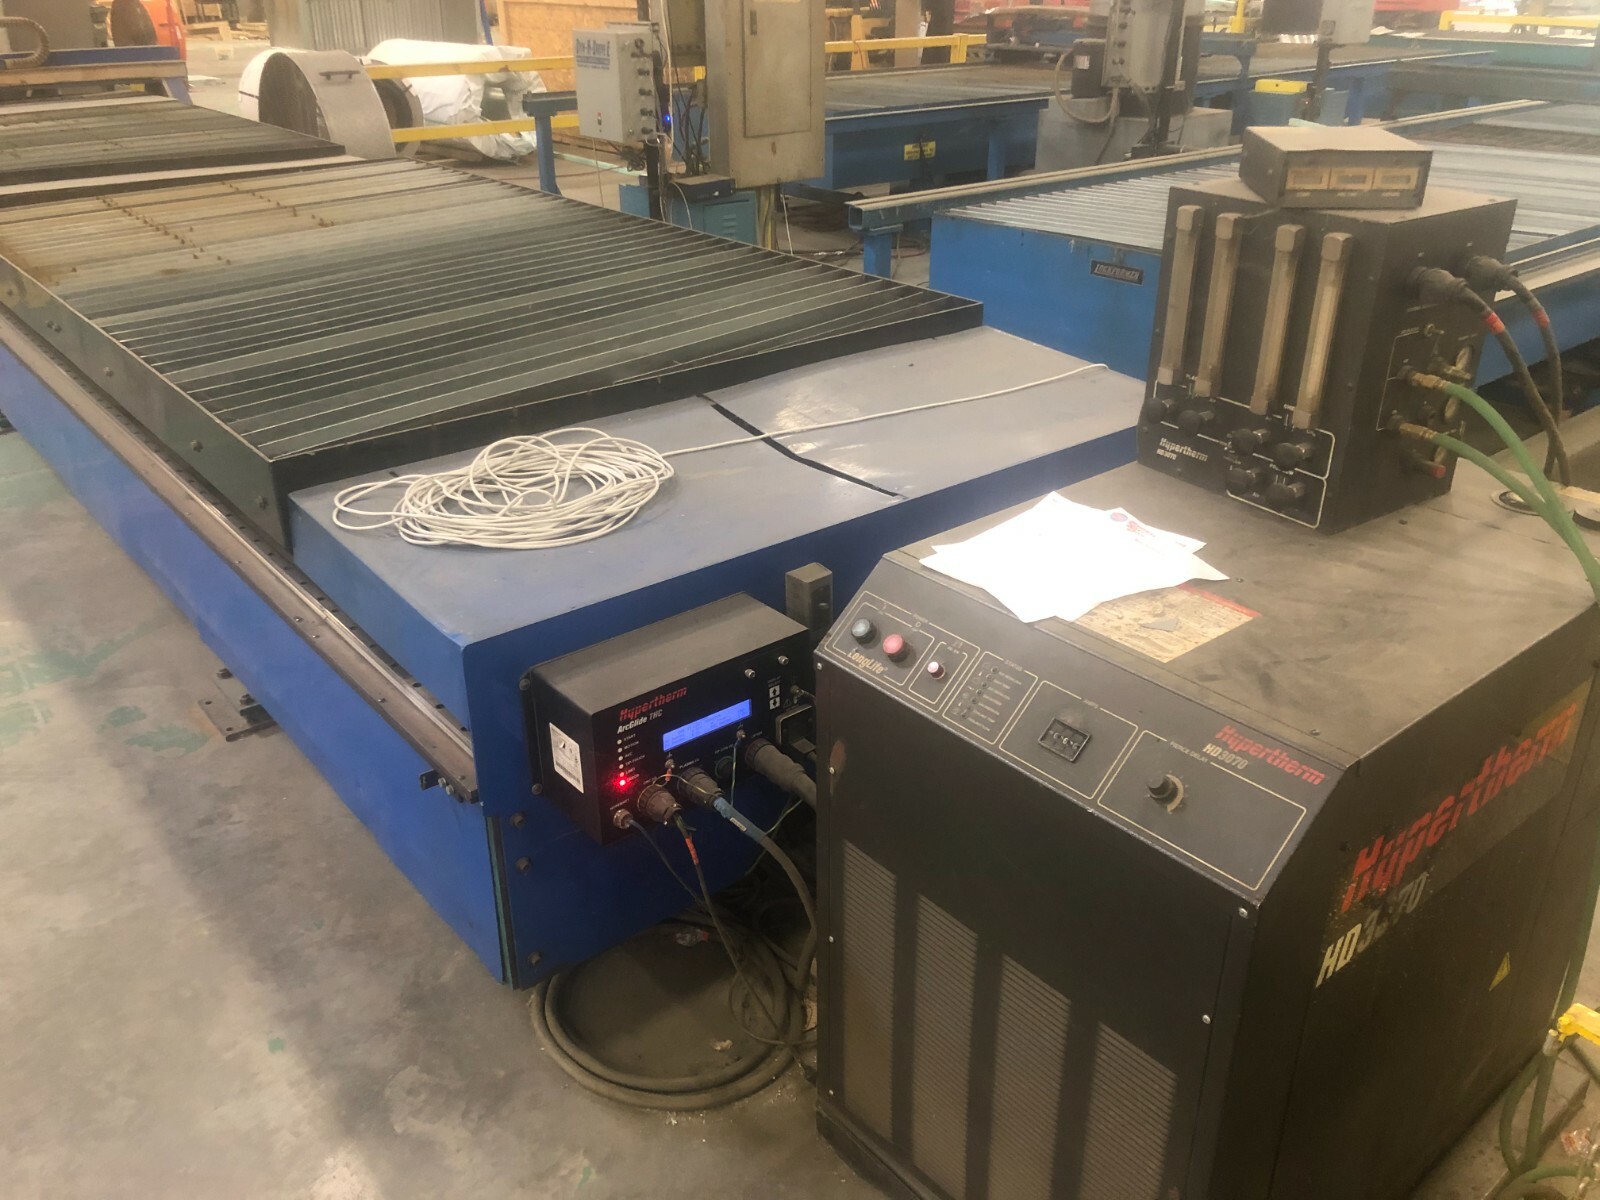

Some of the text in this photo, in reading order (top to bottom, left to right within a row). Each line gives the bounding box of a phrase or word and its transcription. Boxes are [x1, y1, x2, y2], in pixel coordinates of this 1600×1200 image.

[1159, 437, 1208, 462] Hypertherm
[847, 650, 884, 674] LongLife
[619, 687, 687, 722] Hypertherm
[617, 708, 663, 734] ArcGlide THC
[1202, 743, 1249, 771] HD3070
[1215, 724, 1327, 786] Hypertherm
[1341, 703, 1578, 915] Hypertherm
